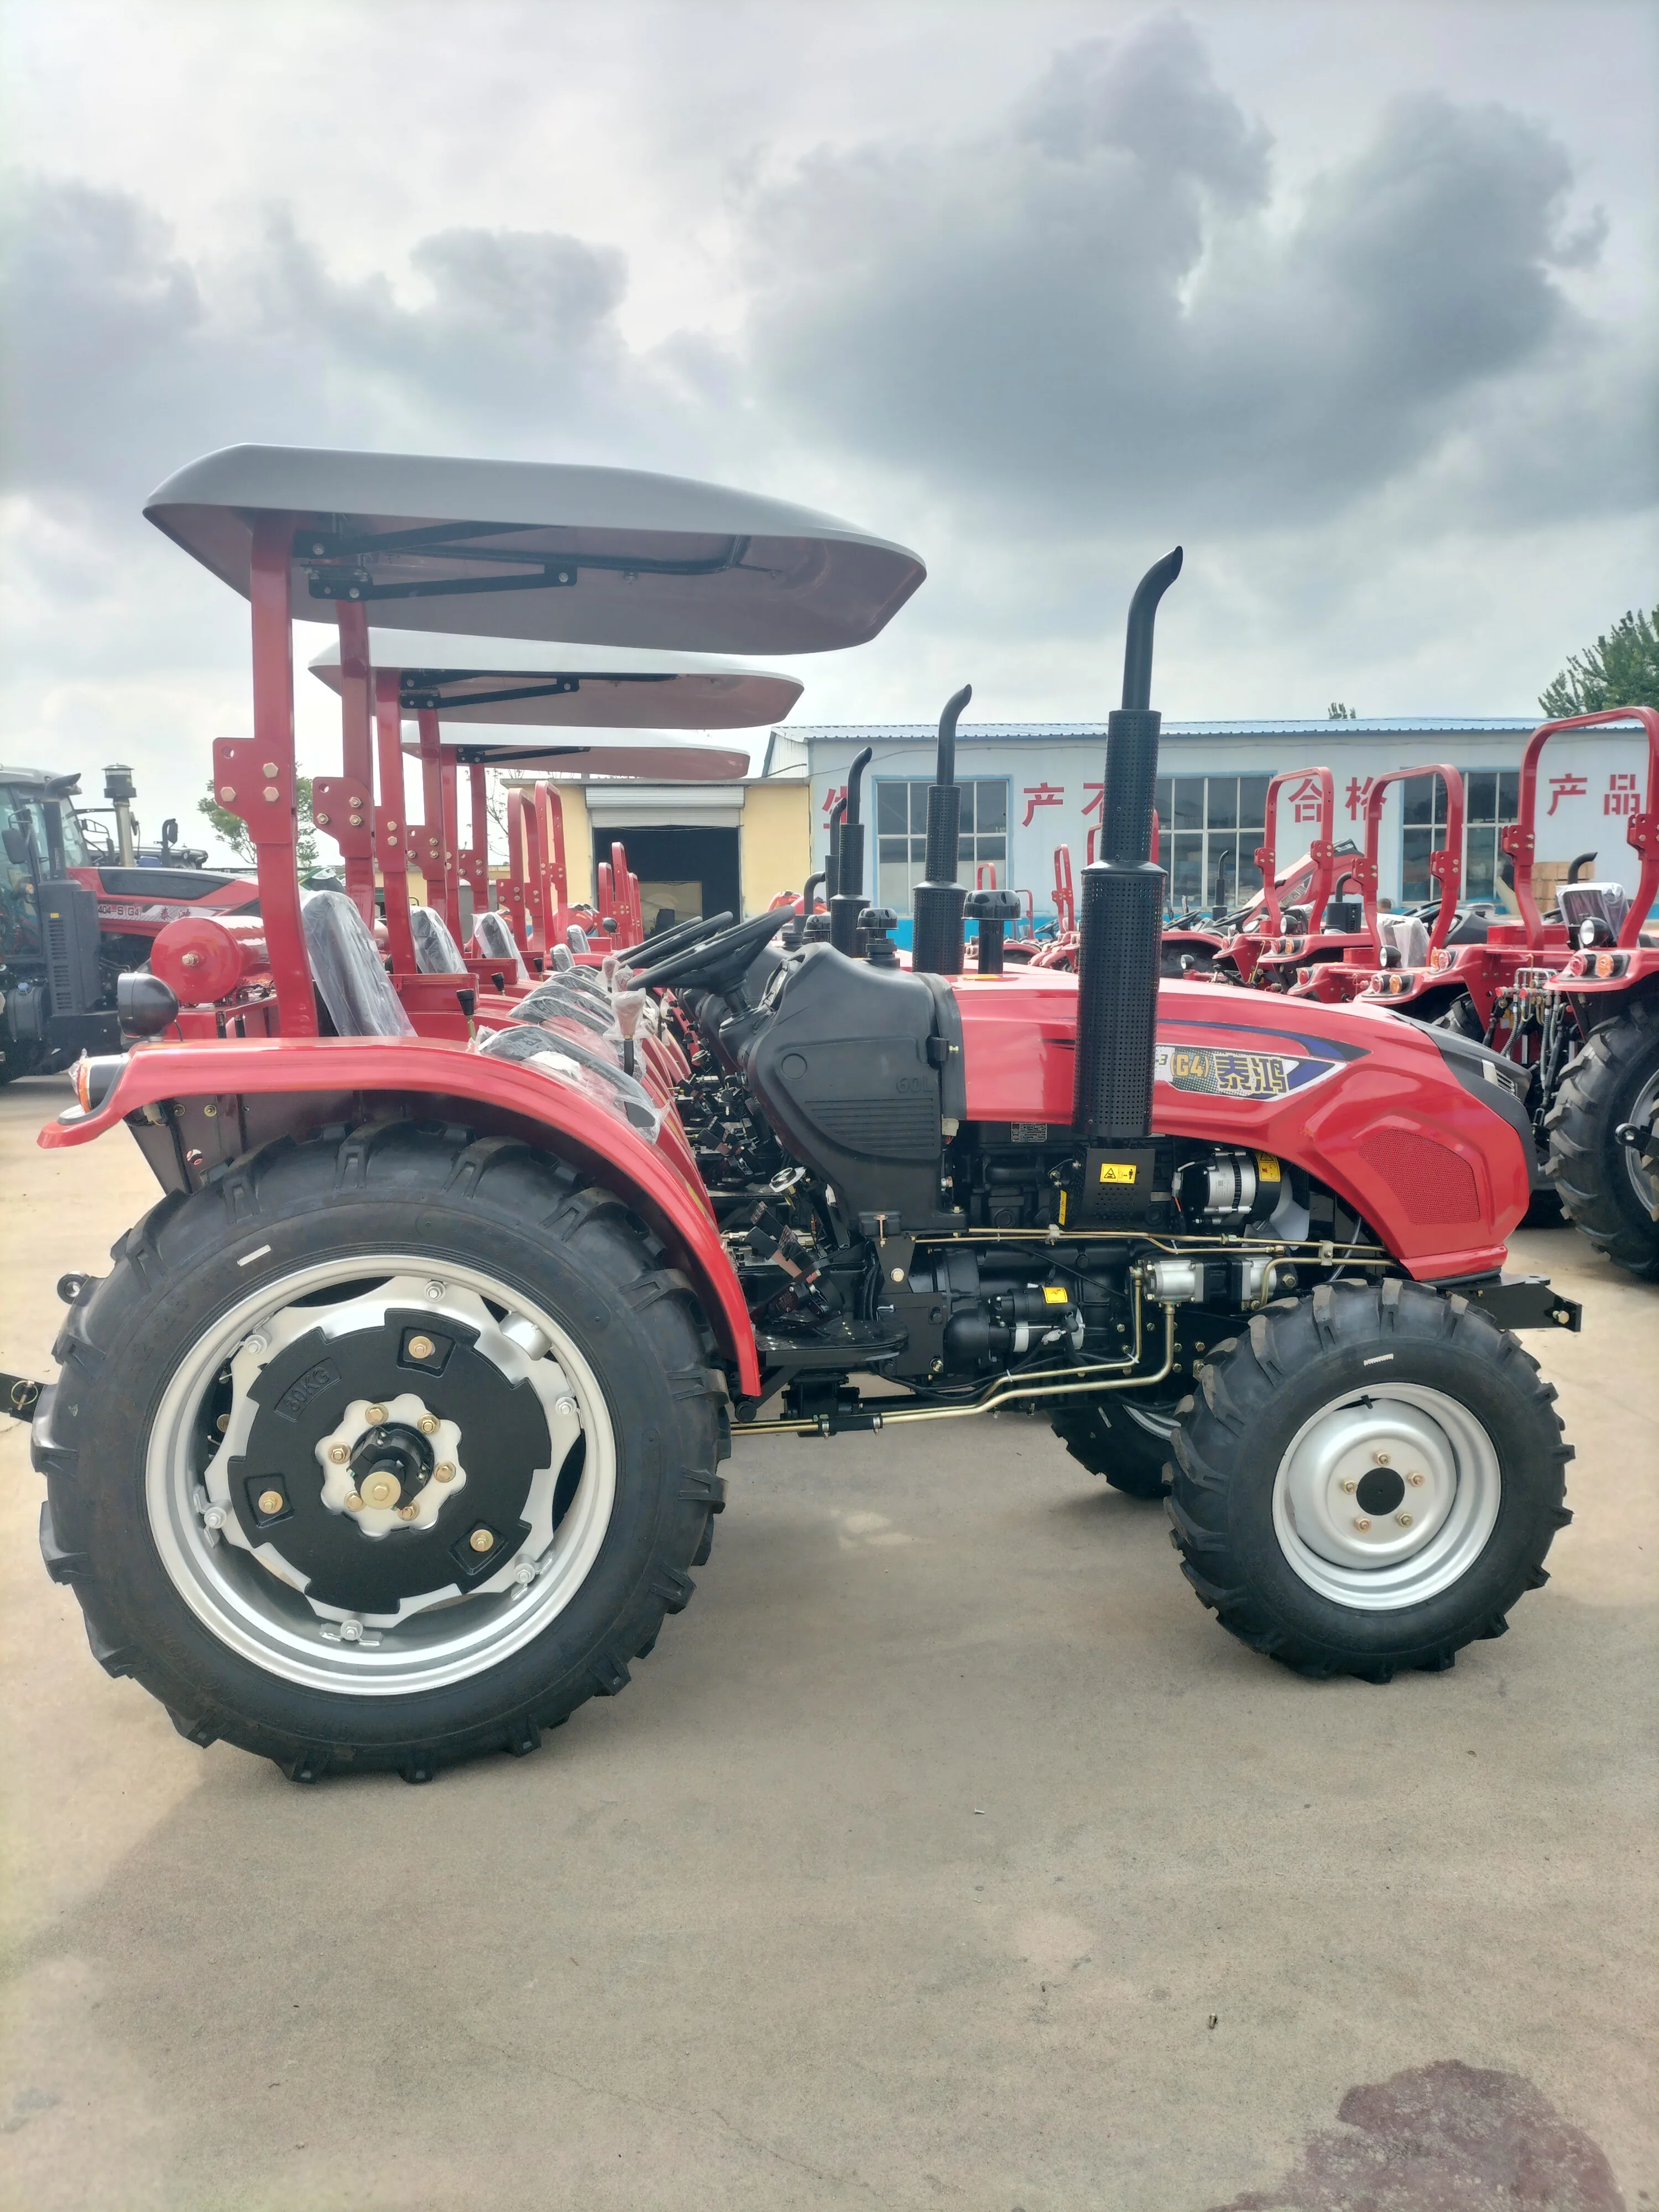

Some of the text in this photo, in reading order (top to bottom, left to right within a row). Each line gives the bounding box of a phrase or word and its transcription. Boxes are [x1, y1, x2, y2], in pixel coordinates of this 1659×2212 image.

[896, 1076, 933, 1093] 60L
[1214, 1054, 1288, 1094] 泰鸿
[284, 1367, 330, 1411] 30KG
